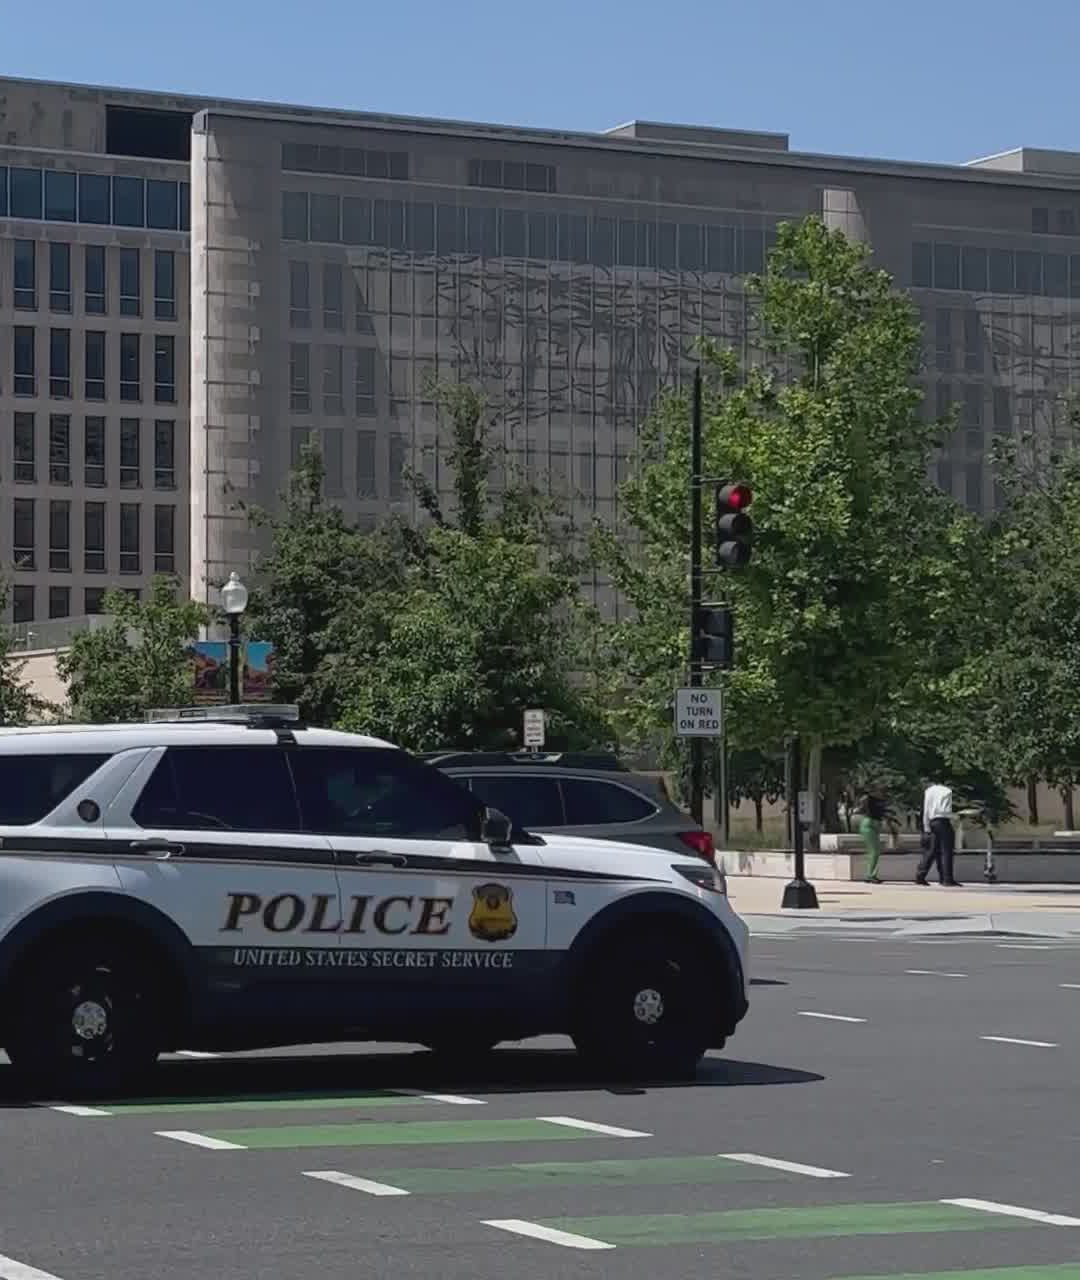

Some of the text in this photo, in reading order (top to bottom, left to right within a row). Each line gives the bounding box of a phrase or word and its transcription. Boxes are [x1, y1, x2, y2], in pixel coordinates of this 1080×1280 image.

[690, 694, 708, 703] NO
[686, 706, 713, 717] TURN
[680, 719, 719, 729] ON RED
[220, 892, 455, 936] POLICE
[233, 948, 514, 969] UNITED STATES SECRET SERVICE
